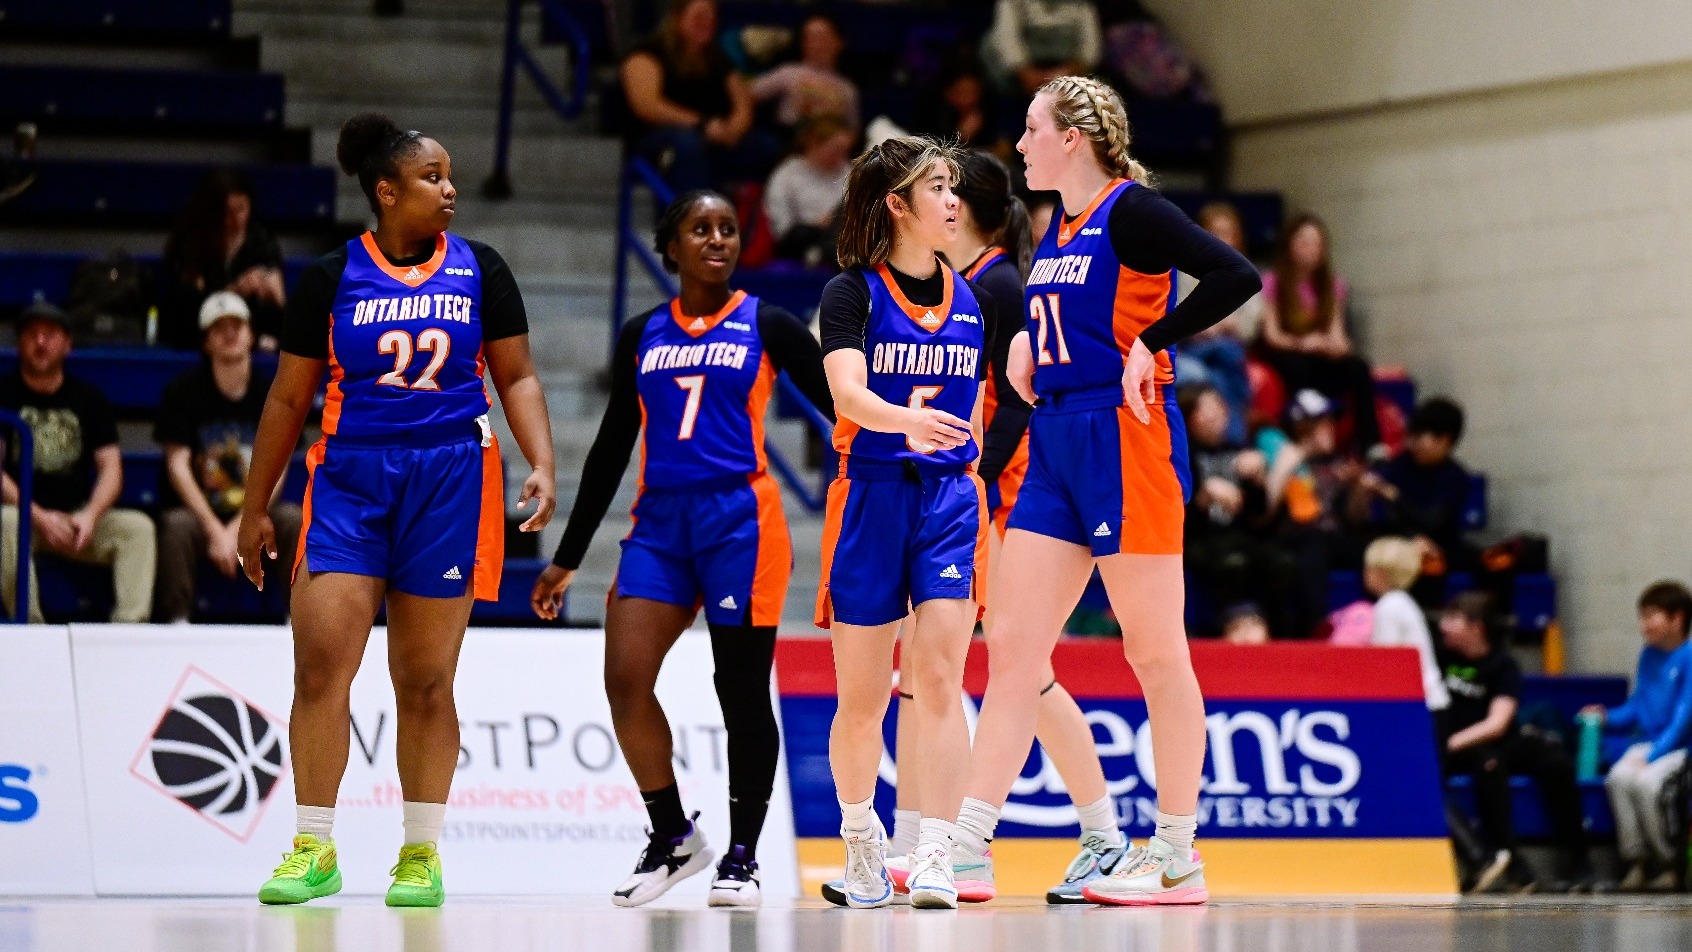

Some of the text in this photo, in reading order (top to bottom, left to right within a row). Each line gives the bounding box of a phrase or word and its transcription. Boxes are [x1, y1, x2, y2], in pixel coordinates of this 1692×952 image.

[1054, 255, 1092, 285] TECH
[353, 294, 472, 326] ONTARIO TECH
[1029, 293, 1072, 366] 21
[375, 328, 451, 391] 22
[641, 341, 748, 375] ONTARIO TECH
[872, 342, 979, 379] ONTARIO TECH
[673, 374, 706, 441] 7
[1112, 797, 1360, 828] UNVERSITY
